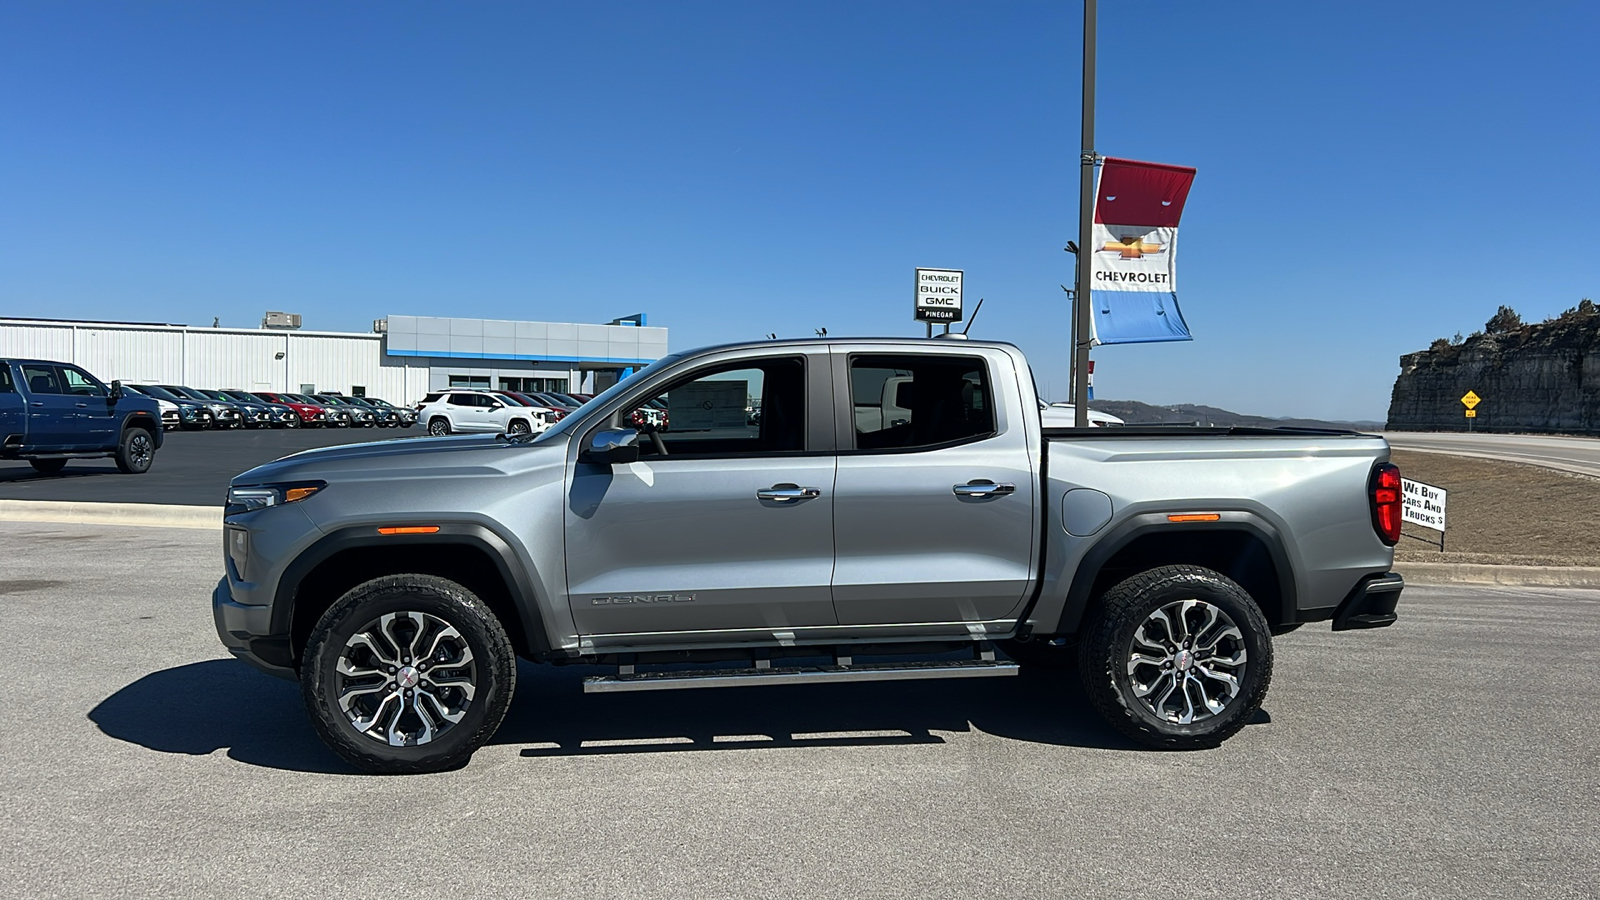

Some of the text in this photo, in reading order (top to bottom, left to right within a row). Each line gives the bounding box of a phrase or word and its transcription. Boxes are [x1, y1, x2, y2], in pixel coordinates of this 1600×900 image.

[921, 274, 959, 283] CHEVROLET
[1095, 271, 1168, 283] CHEVROLET
[920, 285, 959, 294] BUICK
[925, 297, 954, 305] GMC
[591, 593, 696, 605] DENALI
